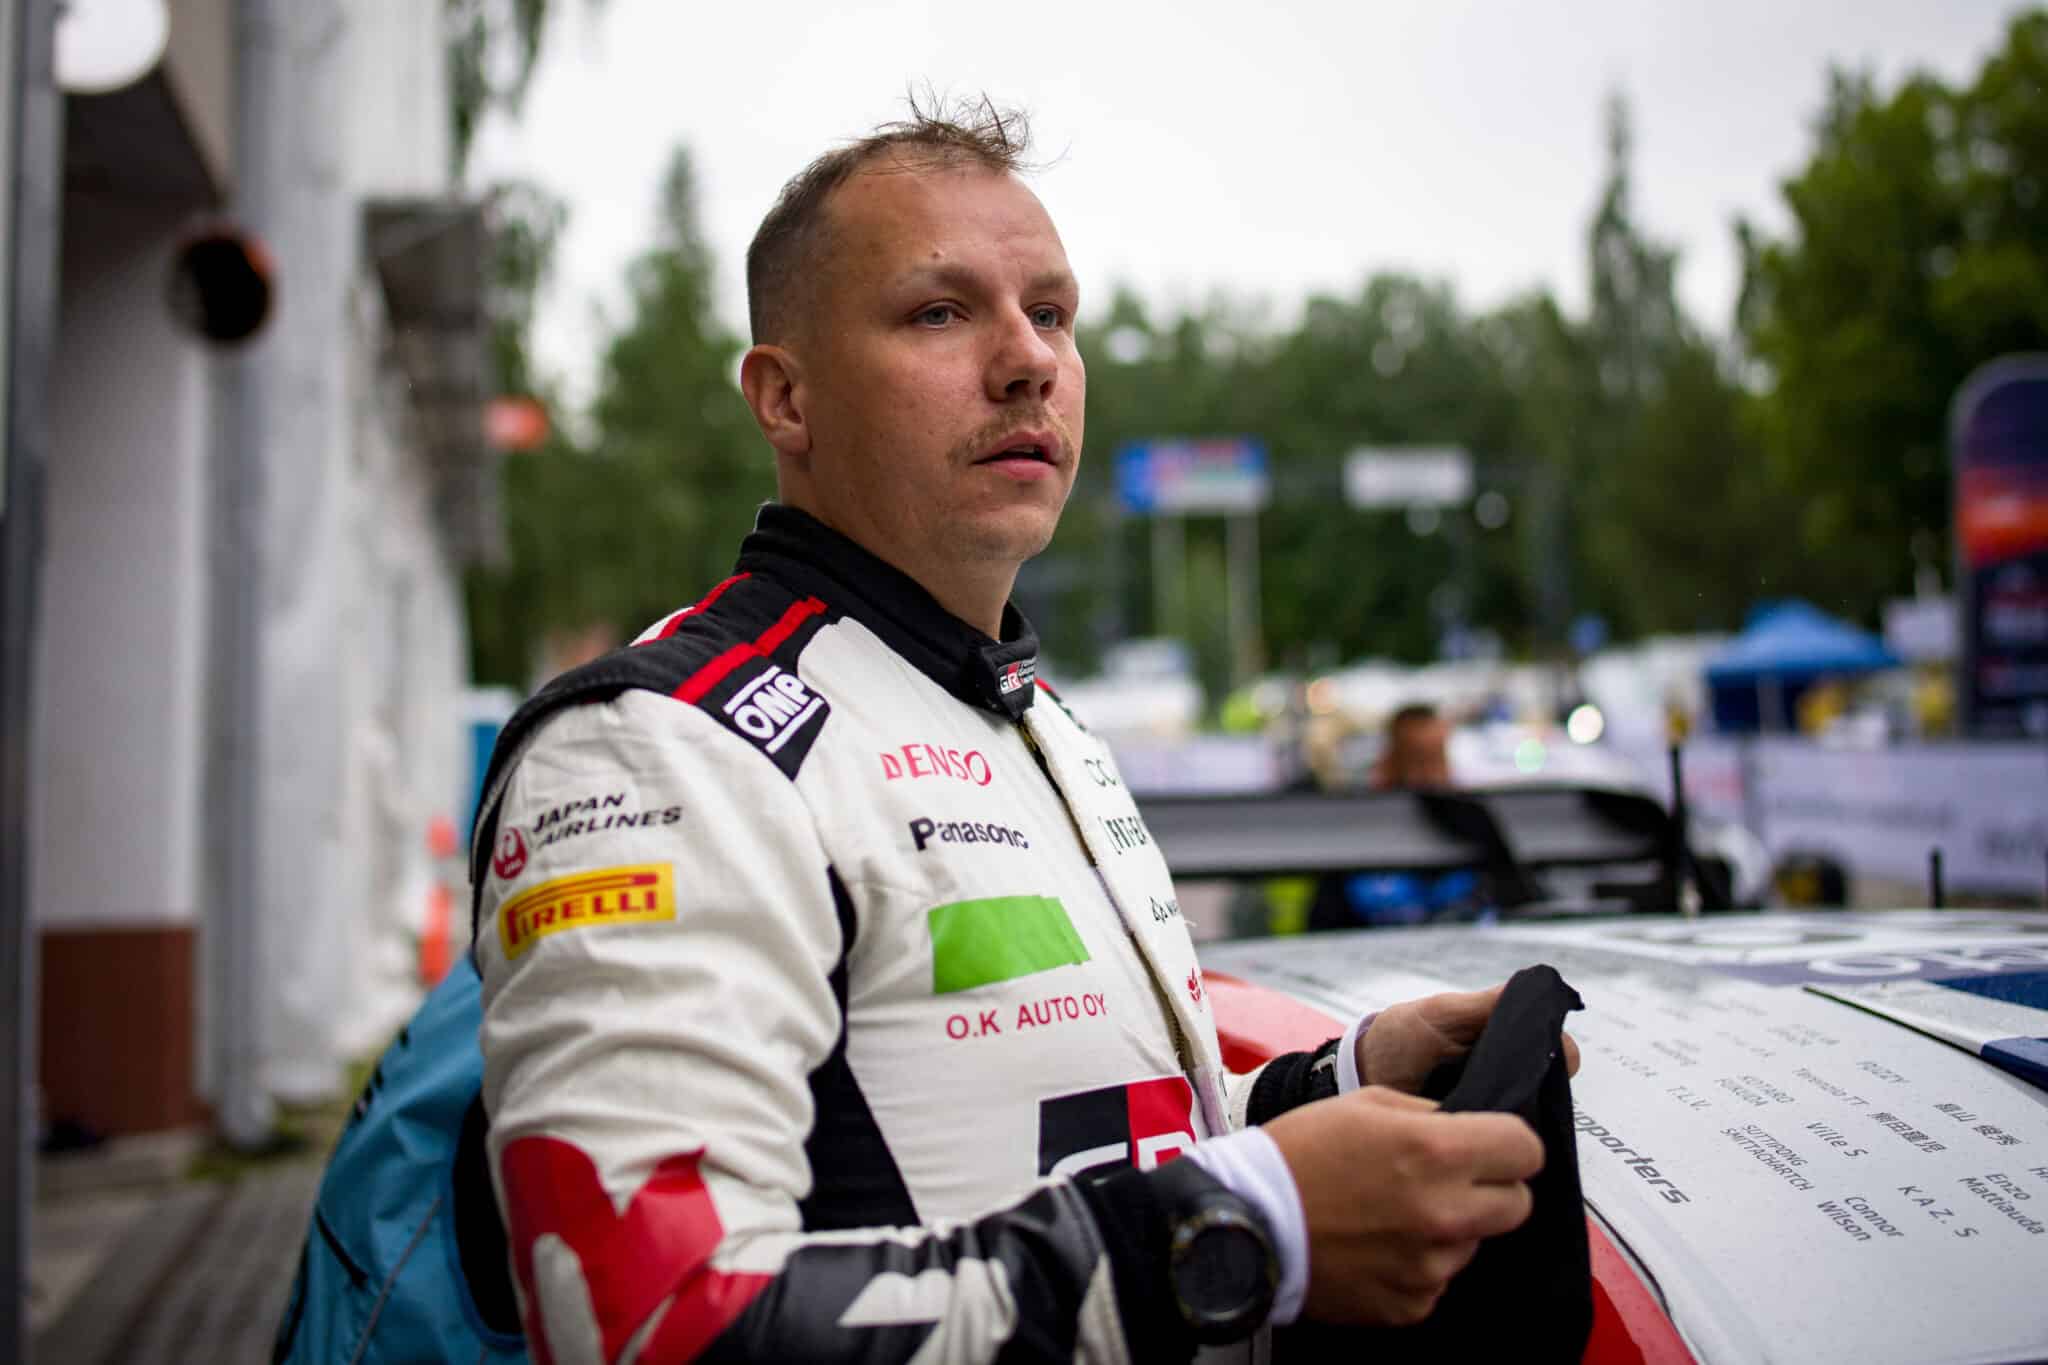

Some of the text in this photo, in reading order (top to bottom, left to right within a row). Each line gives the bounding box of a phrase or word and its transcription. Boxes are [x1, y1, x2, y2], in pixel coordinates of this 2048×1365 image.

[734, 673, 811, 740] OMP
[880, 743, 992, 787] DENSO
[533, 793, 625, 834] JAPAN
[536, 805, 684, 851] AIRLINES
[908, 816, 1030, 852] Panasonic
[507, 873, 659, 946] PIRELLI
[945, 993, 1107, 1040] O.K AUTO OY
[1573, 1109, 1691, 1204] pporters
[1742, 1123, 1808, 1167] SUTTIPONG
[1806, 1121, 1869, 1158] Ville S
[1984, 1172, 2031, 1201] Enzo
[1816, 1200, 1872, 1242] Wilson
[1844, 1196, 1904, 1238] Connor
